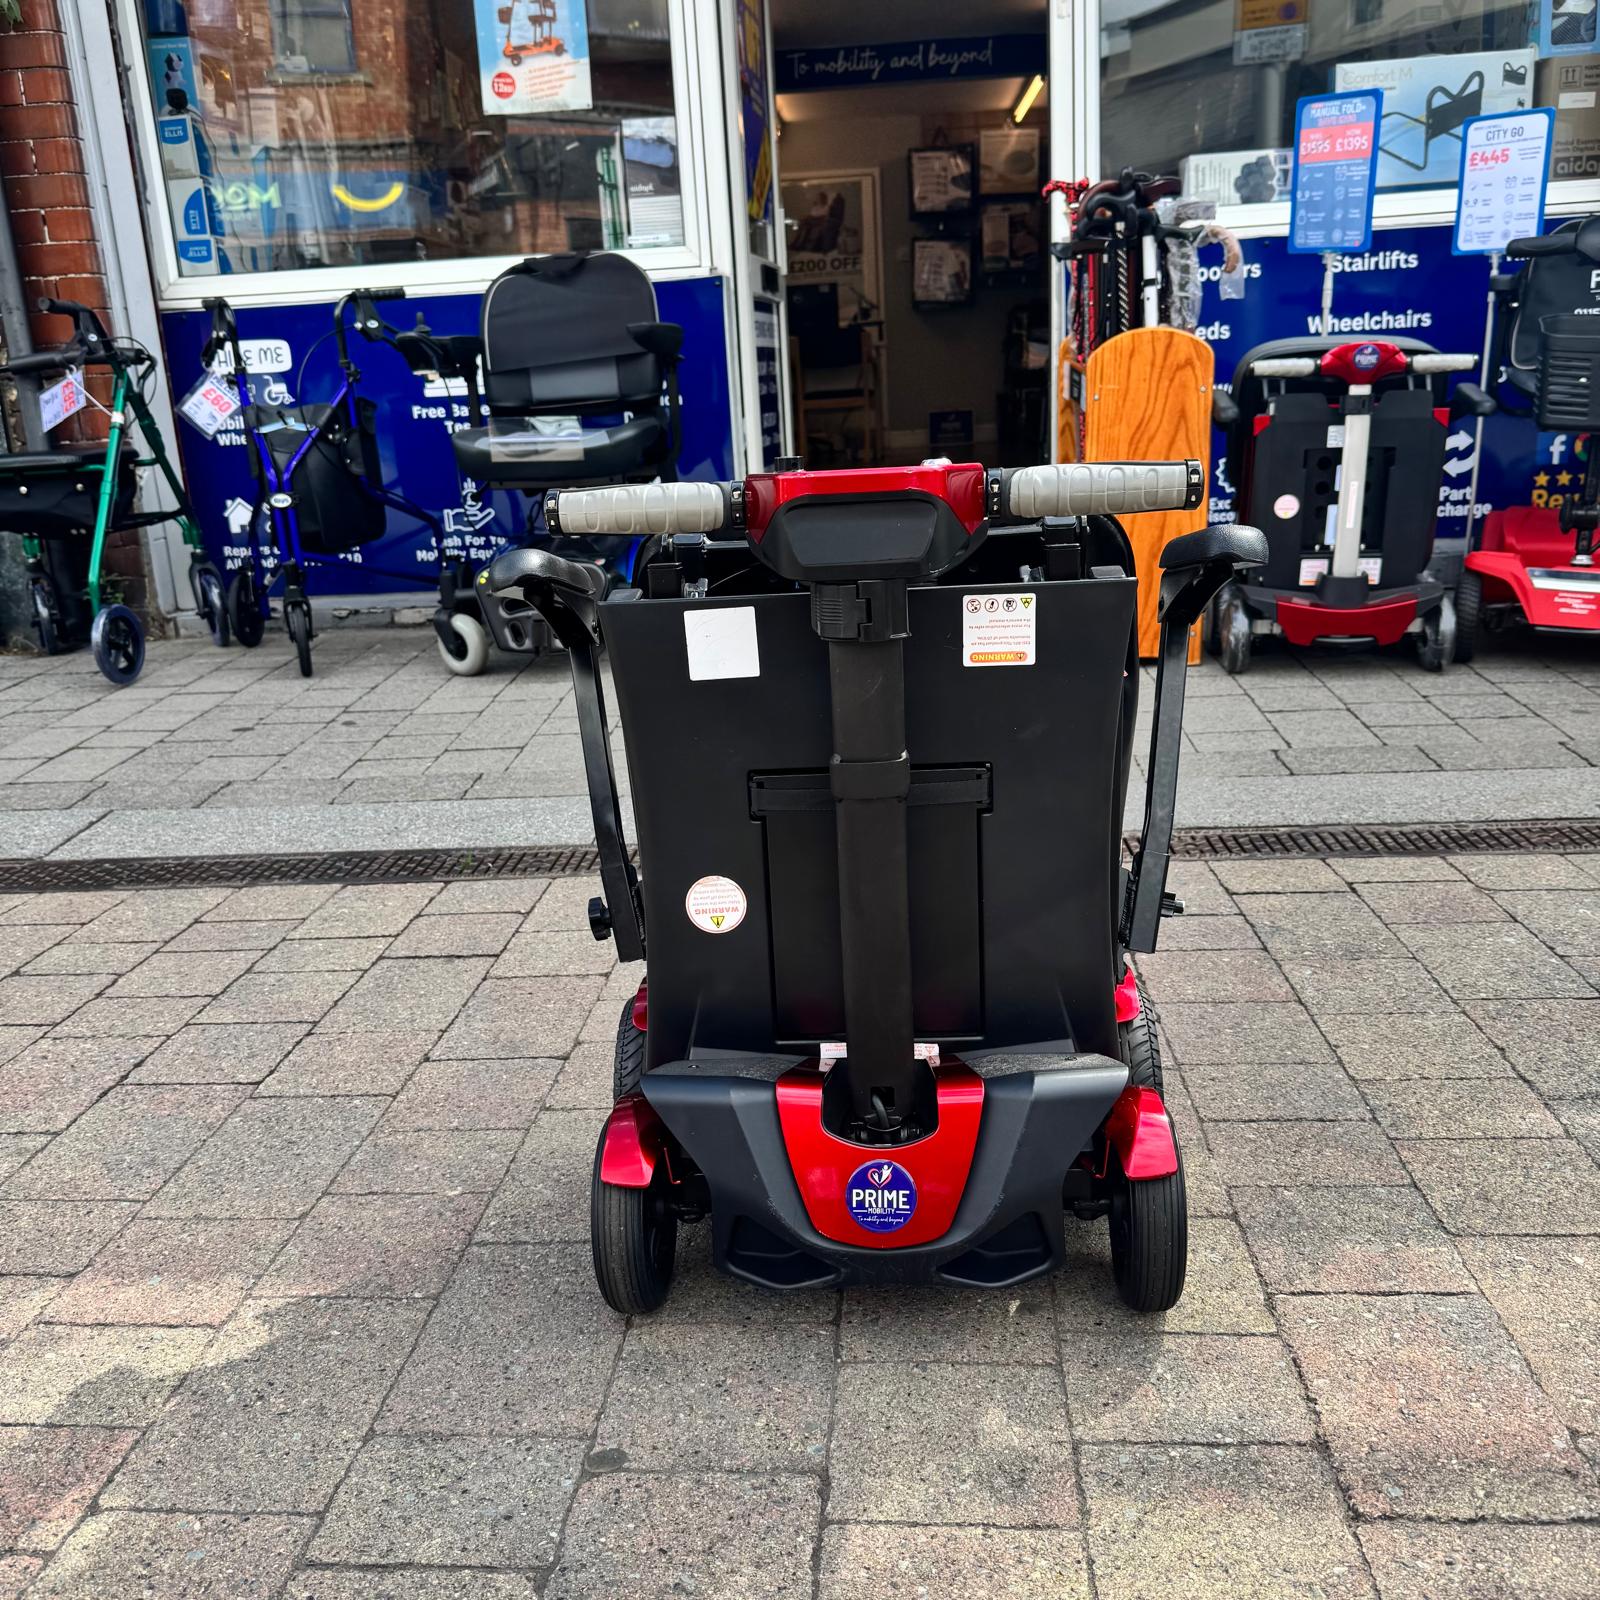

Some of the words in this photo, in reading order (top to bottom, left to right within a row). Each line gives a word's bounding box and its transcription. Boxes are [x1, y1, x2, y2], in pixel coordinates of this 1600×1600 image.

[786, 52, 809, 79] To
[814, 48, 885, 80] mobility
[890, 43, 924, 71] and
[928, 38, 993, 75] beyond
[1485, 127, 1509, 142] CITY
[1510, 126, 1525, 138] GO
[1335, 135, 1369, 153] £1395
[1469, 147, 1510, 168] £445
[1556, 155, 1600, 175] aida
[830, 256, 862, 271] OFF
[1330, 250, 1419, 273] Stairlifts
[1195, 320, 1231, 340] eds
[1307, 309, 1432, 334] Wheelchairs
[202, 387, 233, 413] £60
[411, 404, 447, 419] Free
[1439, 485, 1473, 501] Part
[1436, 502, 1493, 519] change
[464, 534, 487, 546] For
[972, 653, 1015, 661] WARNING
[694, 906, 740, 915] WARNING
[852, 1188, 910, 1209] PRIME
[868, 1207, 895, 1215] MOBILITY
